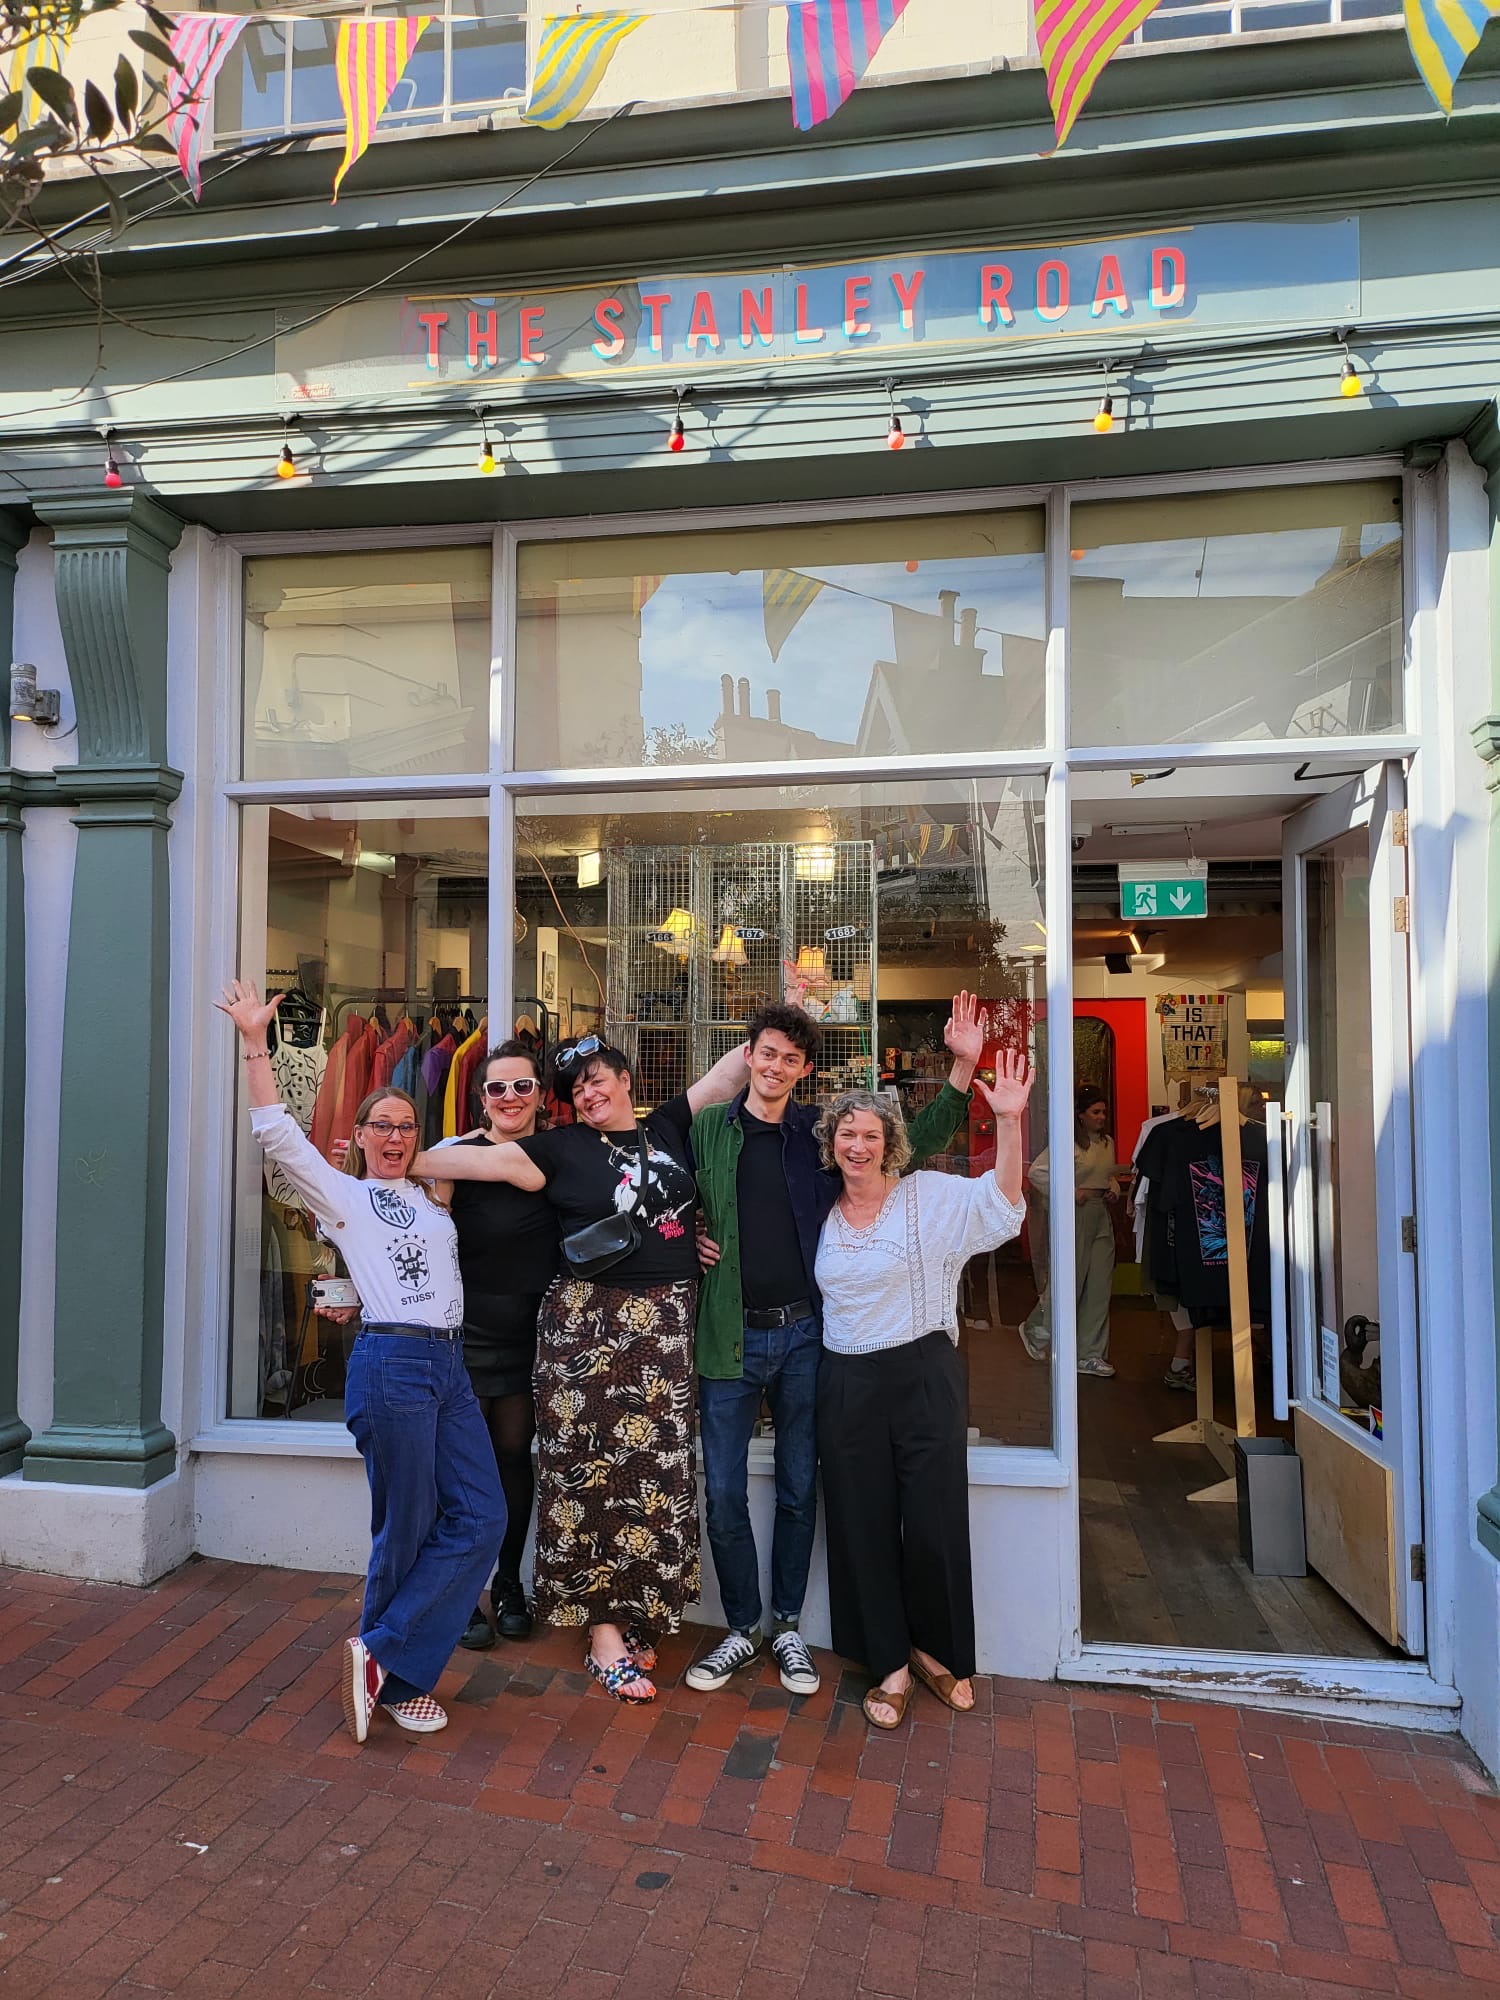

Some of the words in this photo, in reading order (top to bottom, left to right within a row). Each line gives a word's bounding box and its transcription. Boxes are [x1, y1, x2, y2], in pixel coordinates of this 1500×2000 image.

[417, 306, 546, 370] THE
[592, 270, 925, 359] STANLEY
[979, 246, 1187, 328] ROAD
[651, 932, 671, 943] 166
[740, 929, 759, 940] 167
[831, 927, 851, 939] 168
[1185, 1007, 1202, 1023] IS
[1170, 1025, 1217, 1041] THAT
[1185, 1045, 1212, 1061] IT?
[401, 1290, 436, 1306] STUSSY
